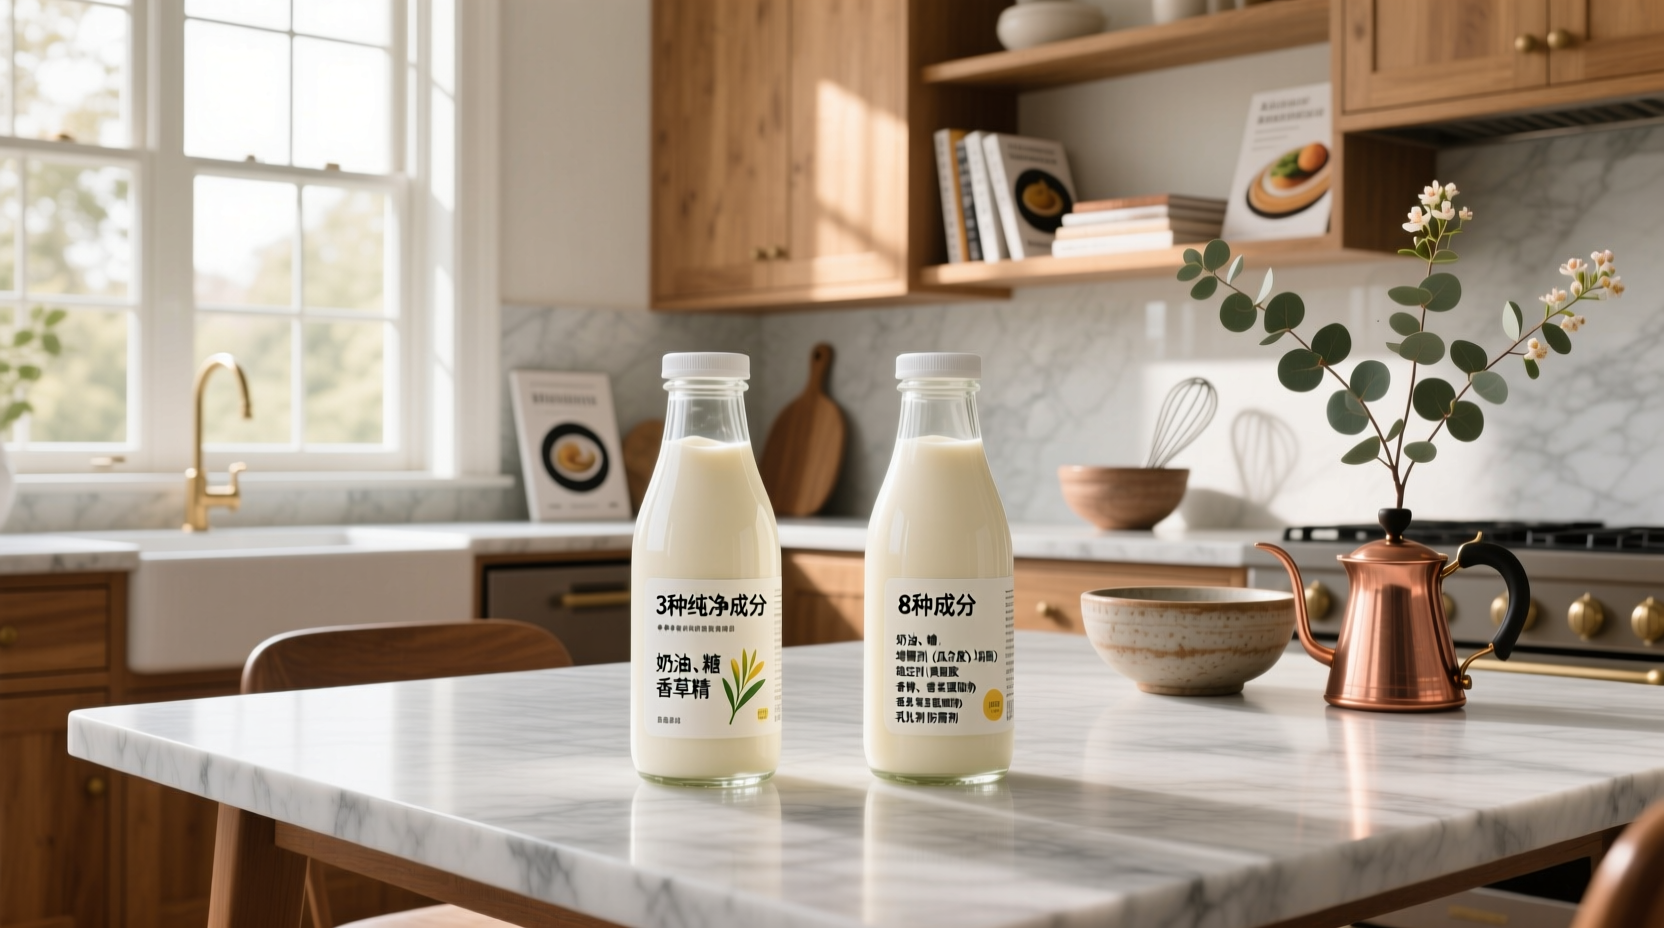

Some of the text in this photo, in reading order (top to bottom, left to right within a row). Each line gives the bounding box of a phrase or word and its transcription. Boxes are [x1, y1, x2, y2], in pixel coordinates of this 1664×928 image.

[656, 593, 767, 617] 3种纯净成分
[898, 593, 976, 617] 8种成分
[656, 653, 721, 674] 奶油、糖
[656, 677, 711, 700] 香草精
